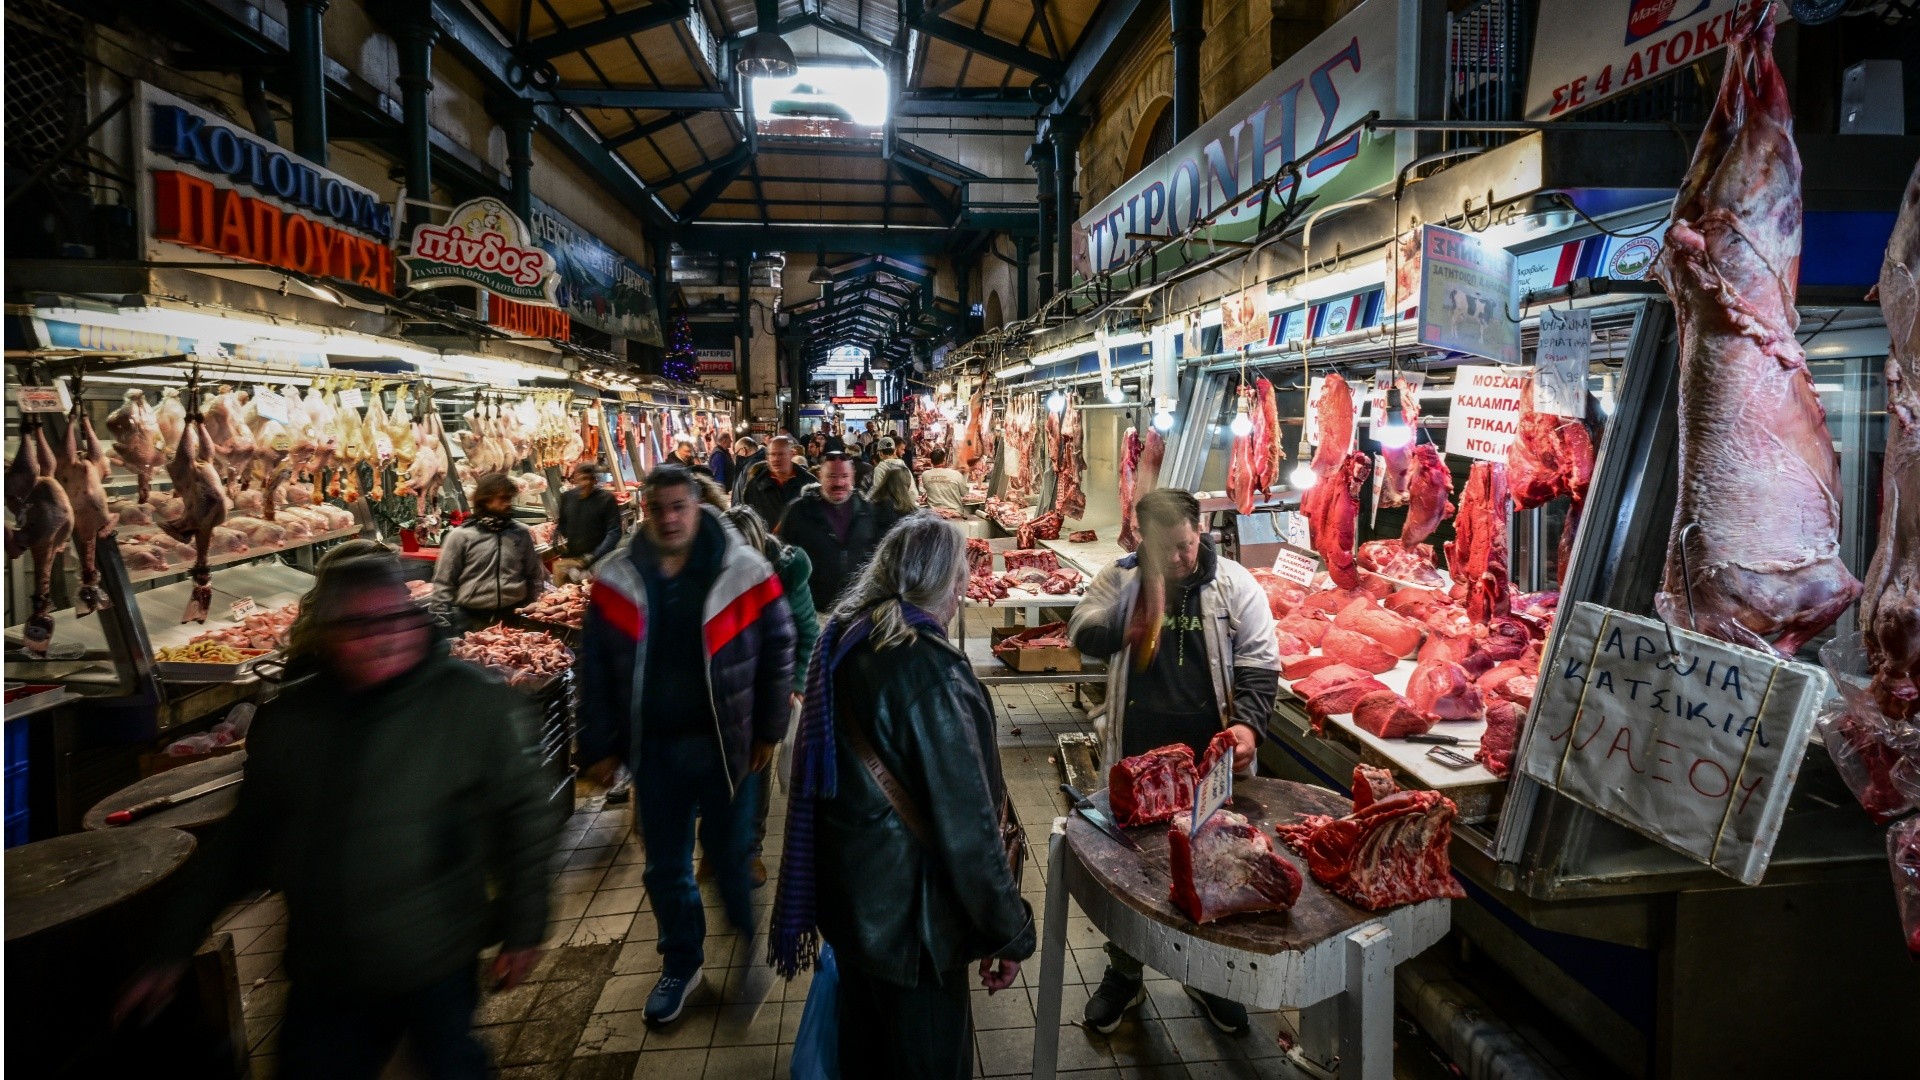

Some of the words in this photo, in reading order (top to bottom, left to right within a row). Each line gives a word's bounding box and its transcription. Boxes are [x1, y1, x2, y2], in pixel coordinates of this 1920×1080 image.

[1549, 75, 1587, 115] ΣΕ
[1594, 64, 1612, 95] 4
[1621, 2, 1760, 86] ΑΤΟΚΕ
[165, 104, 393, 238] ΚΟΤΟΠΟΥΛΑ
[165, 170, 395, 296] ΠΑΠΟΥΤΣΗ
[419, 227, 541, 284] πίνδος
[414, 268, 426, 278] ΤΑ
[426, 266, 466, 277] ΝΟΣΤΙΜΑ
[467, 270, 495, 287] ΟΡΕΙΝΑ
[496, 282, 543, 297] ΚΟΤΟΠΟΥΛΑ
[498, 297, 570, 342] ΠΑΠΟΥΤΣΗ
[1457, 395, 1520, 412] ΚΑΛΑΜΠΑ
[1279, 557, 1314, 573] ΚΑΛΑΜΠΑΚΑ
[1286, 553, 1311, 565] ΜΟΣΧΑΡΙ
[1564, 656, 1770, 747] ΚΑΤΣΙΚΙΑ
[1550, 709, 1763, 814] ΝΑΞΟΥ
